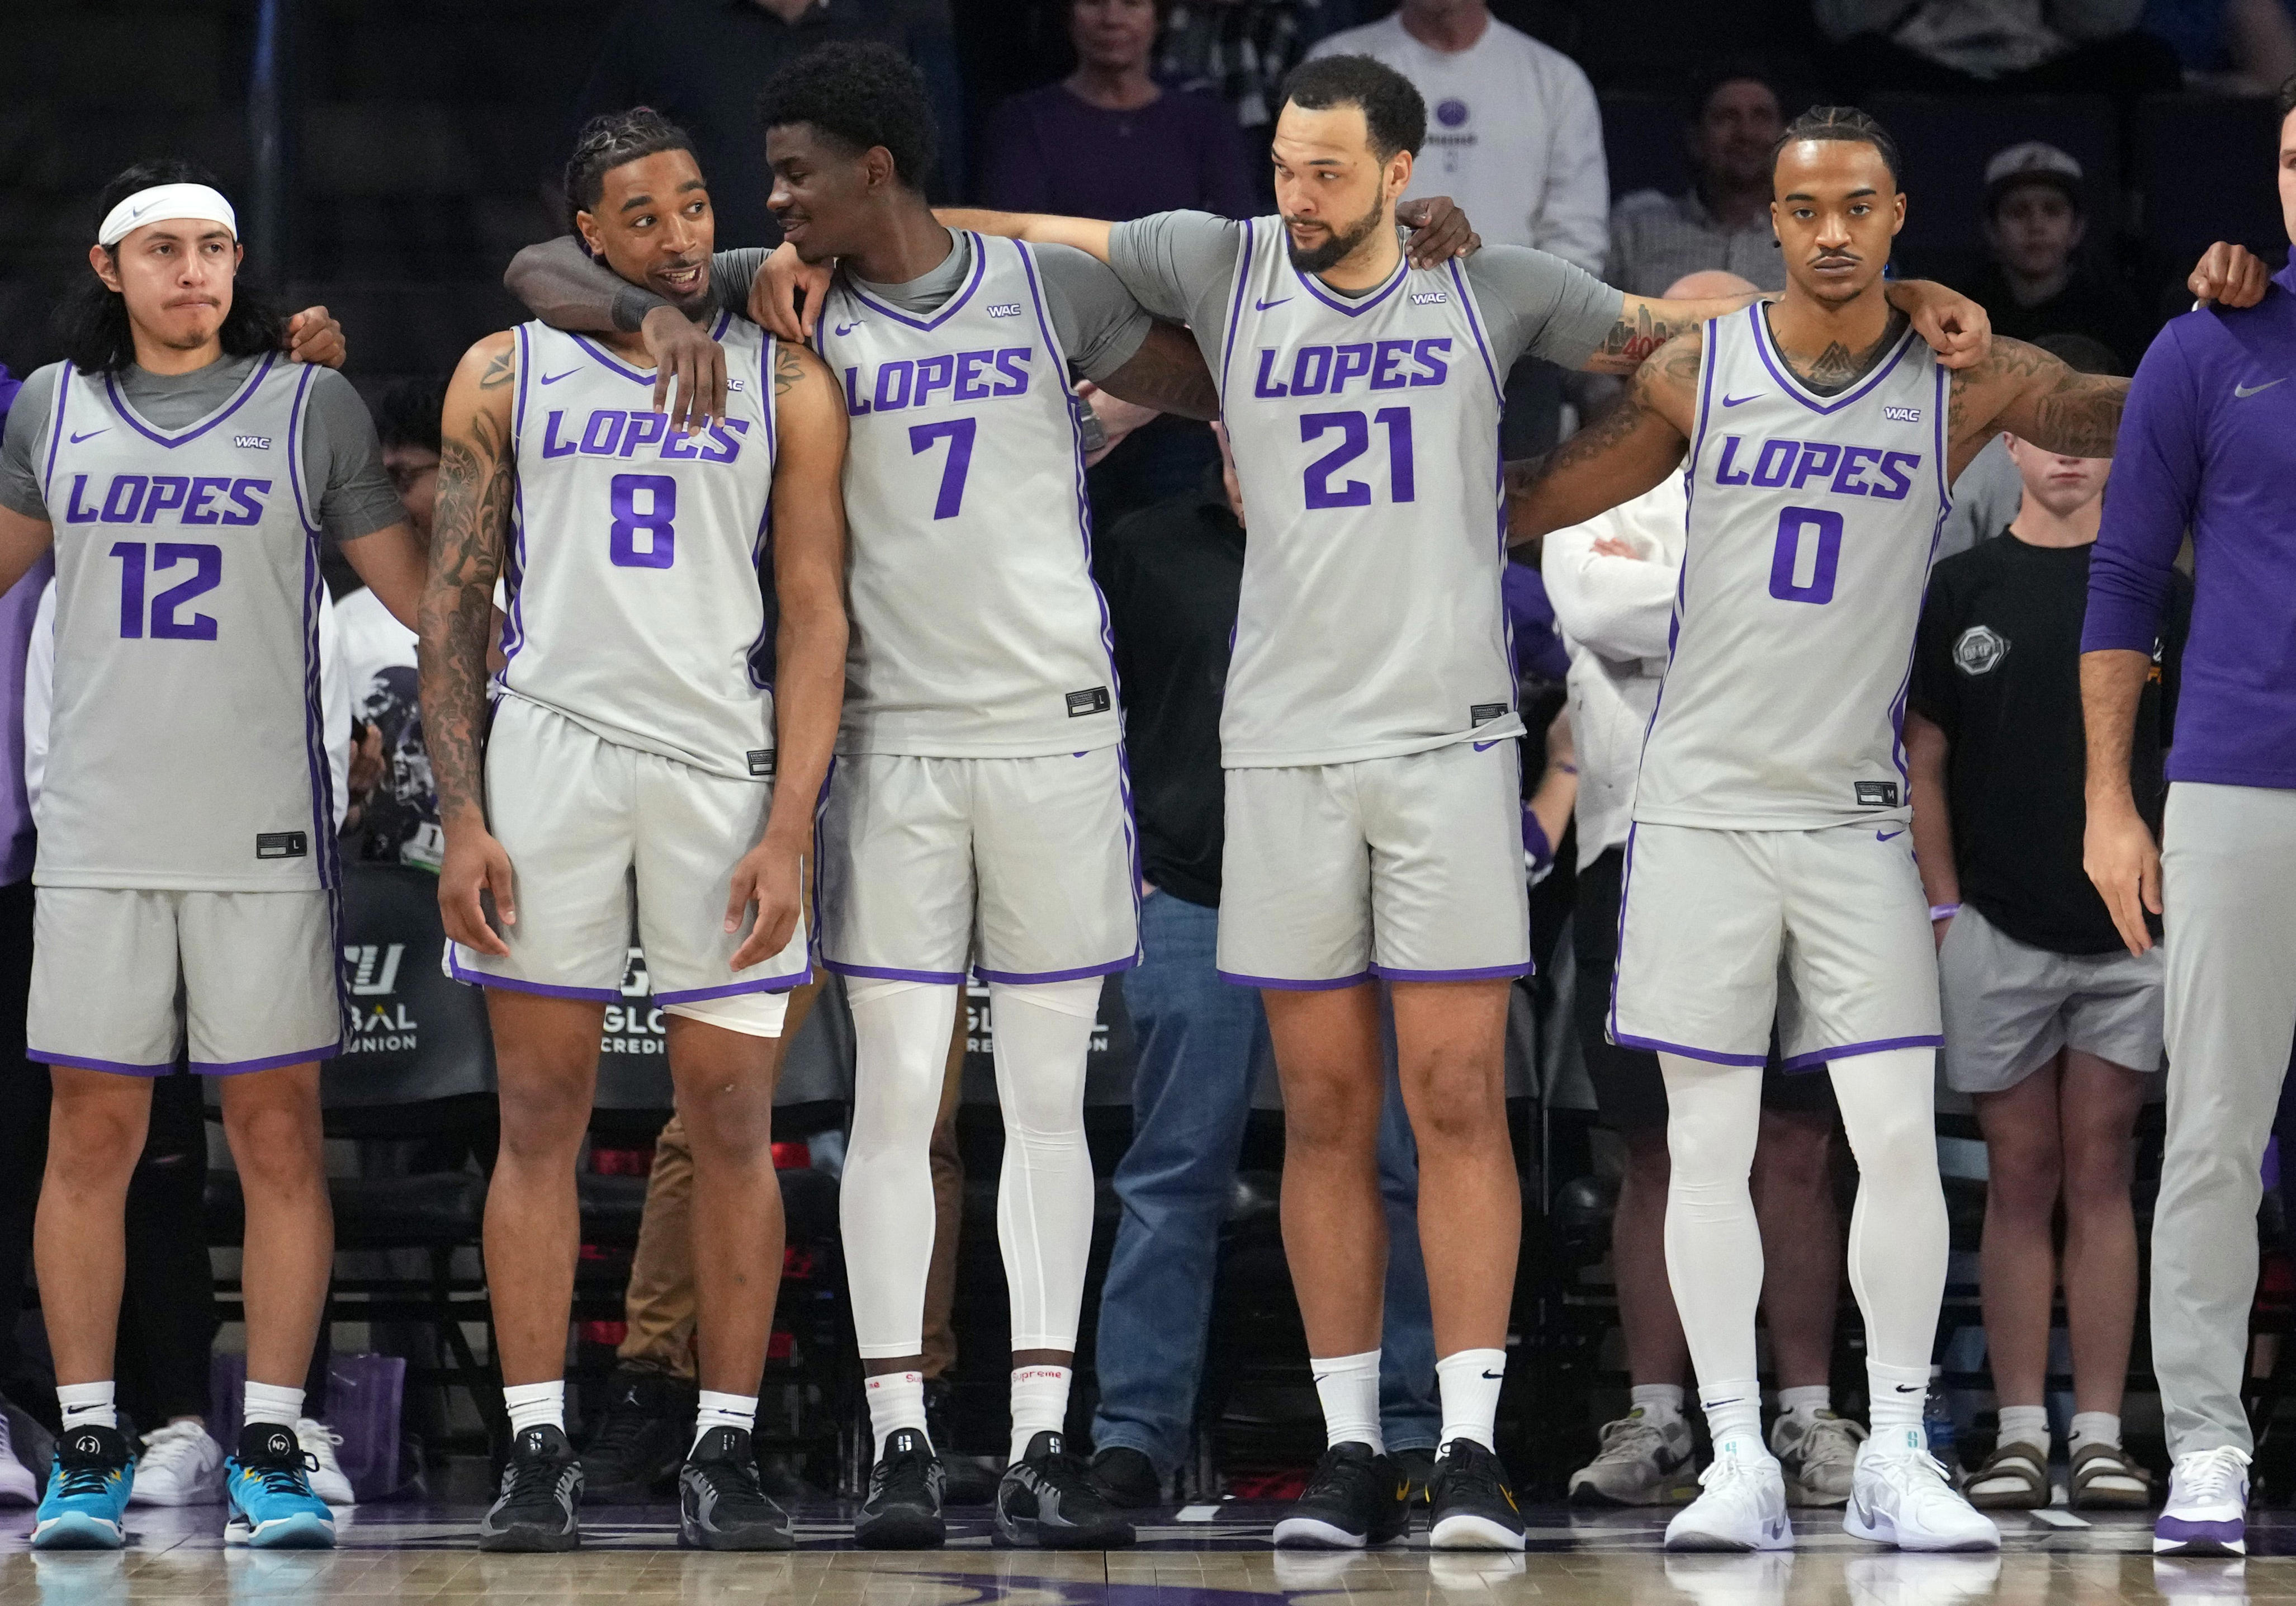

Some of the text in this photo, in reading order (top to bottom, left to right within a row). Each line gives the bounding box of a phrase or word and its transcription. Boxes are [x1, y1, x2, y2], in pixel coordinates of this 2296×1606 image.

[987, 304, 1021, 318] WAC
[1412, 293, 1446, 305] WAC
[727, 379, 744, 391] AC
[845, 347, 1031, 416] LOPES
[1254, 338, 1452, 398] LOPES
[542, 410, 750, 464] LOPES
[1884, 407, 1921, 422] WAC
[234, 436, 271, 450] WAC
[908, 417, 976, 521] 7
[1300, 407, 1414, 509] 21
[1716, 436, 1921, 500] LOPES
[66, 474, 272, 526] LOPES
[610, 474, 676, 569] 8
[1769, 506, 1844, 605] 0
[109, 542, 223, 640] 12
[293, 840, 299, 849] L
[600, 1038, 665, 1054] CREDI
